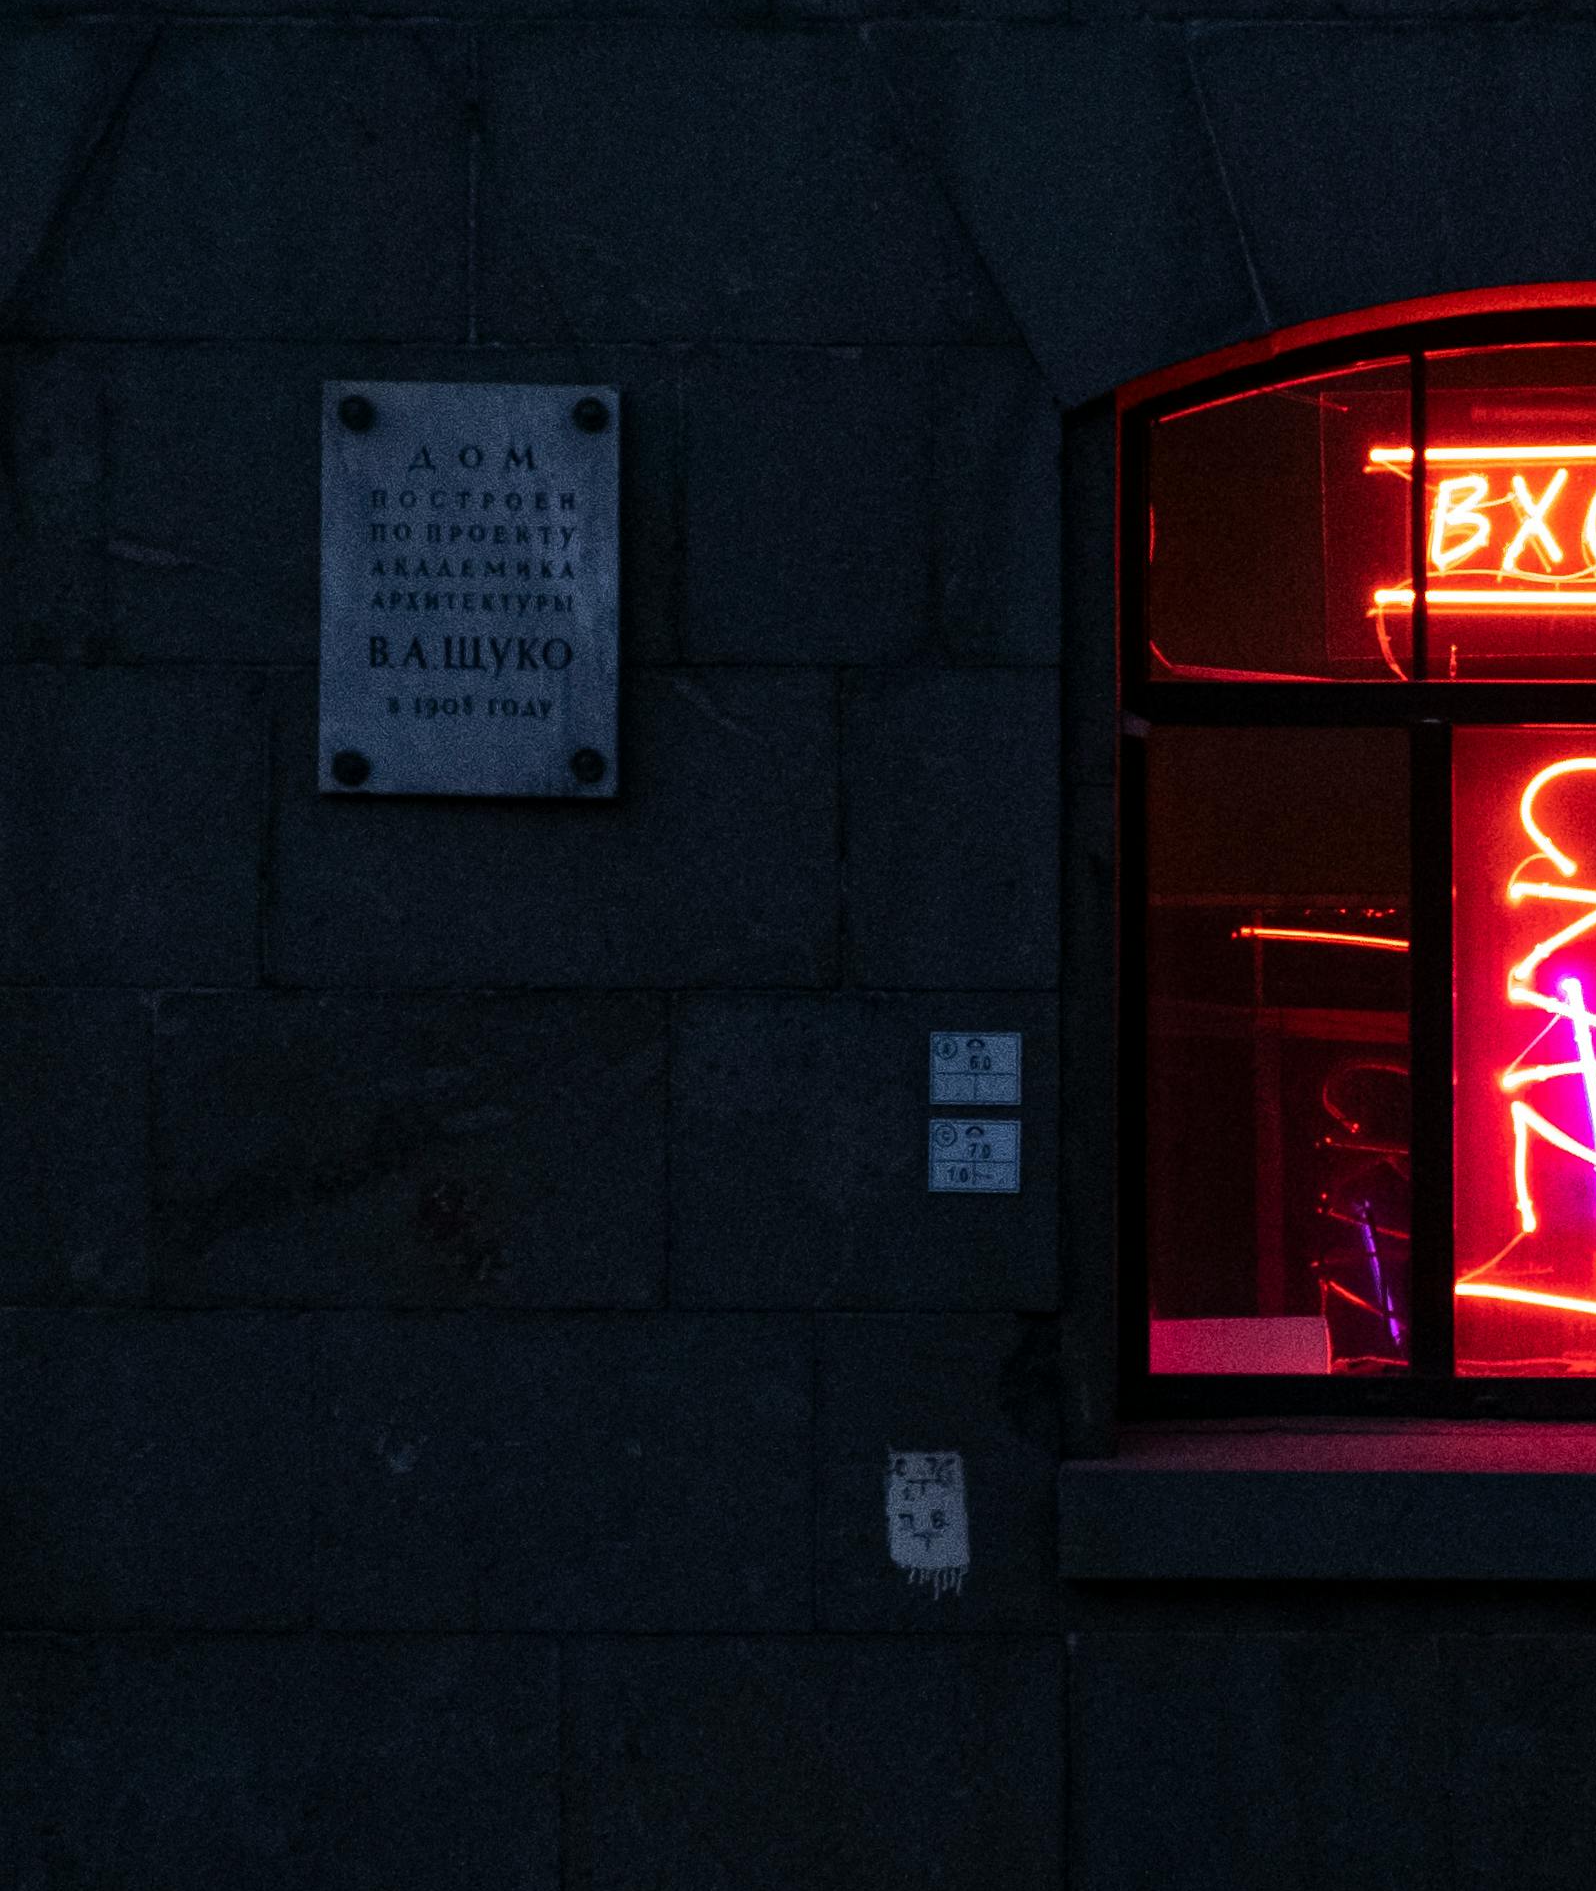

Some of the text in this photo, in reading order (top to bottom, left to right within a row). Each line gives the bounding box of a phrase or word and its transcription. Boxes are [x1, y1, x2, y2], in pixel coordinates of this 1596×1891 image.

[408, 445, 537, 474] ДОМ
[370, 489, 576, 511] ПОСТРОЕН
[370, 522, 576, 549] ПО ПРОЕКТУ
[370, 557, 576, 580] АКАДЕМИКА
[371, 591, 574, 617] АРХИТЕКТУРЫ
[488, 698, 553, 720] ГОДУ
